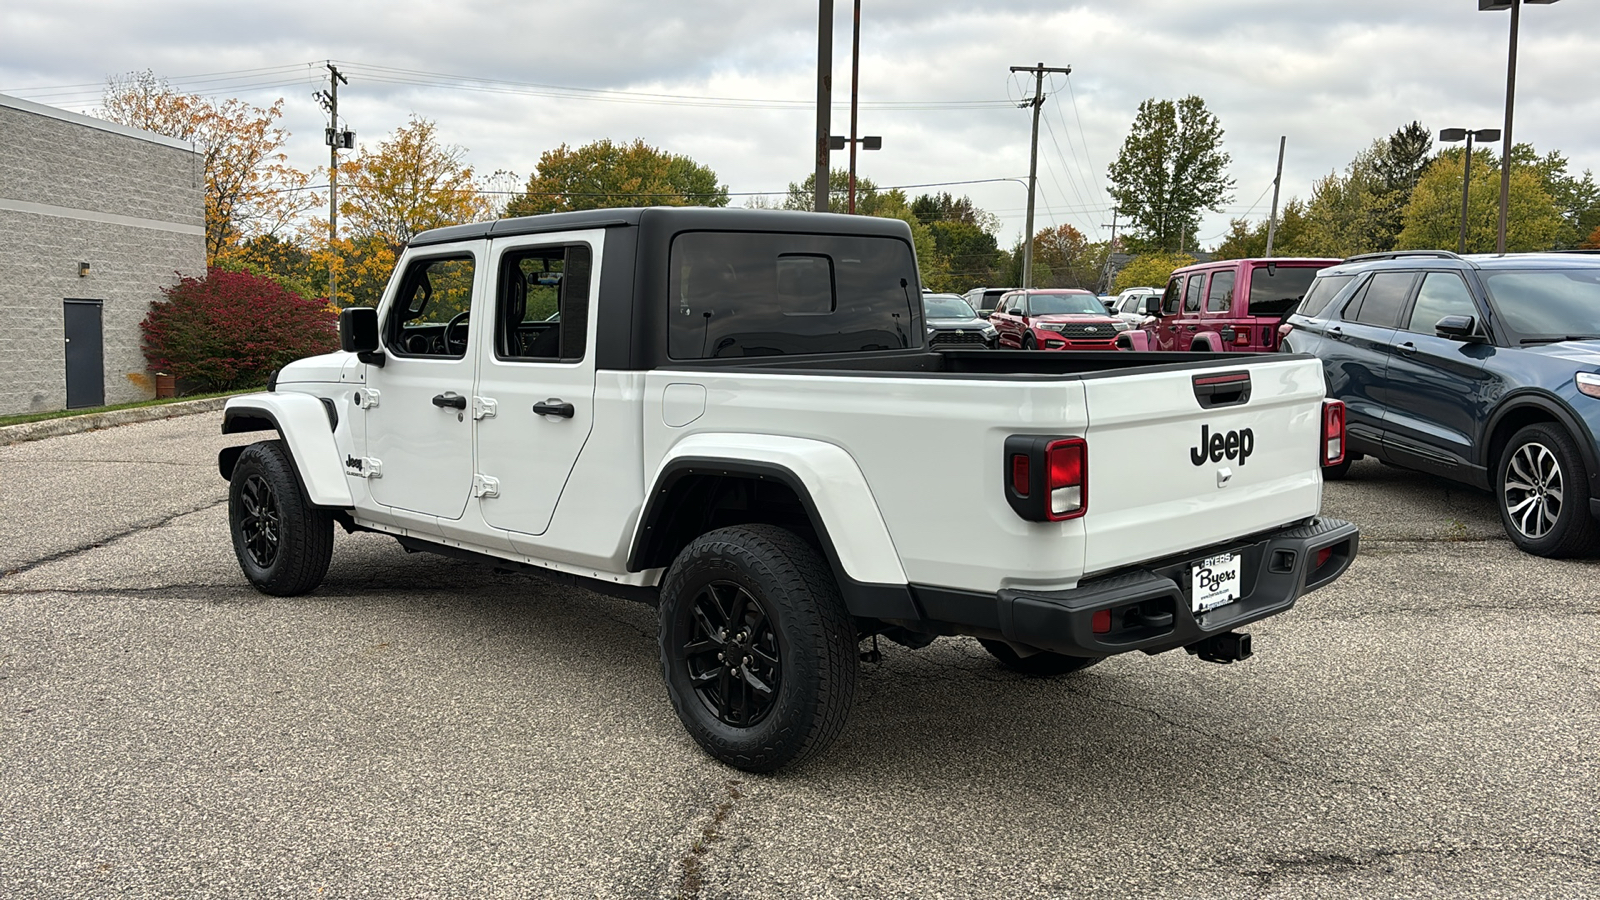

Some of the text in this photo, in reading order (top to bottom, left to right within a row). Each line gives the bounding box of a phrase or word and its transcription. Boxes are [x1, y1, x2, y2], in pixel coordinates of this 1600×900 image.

[1190, 424, 1254, 466] Jeep
[345, 454, 363, 472] Jeep
[1204, 552, 1231, 567] BYERS
[1195, 568, 1236, 592] Byers
